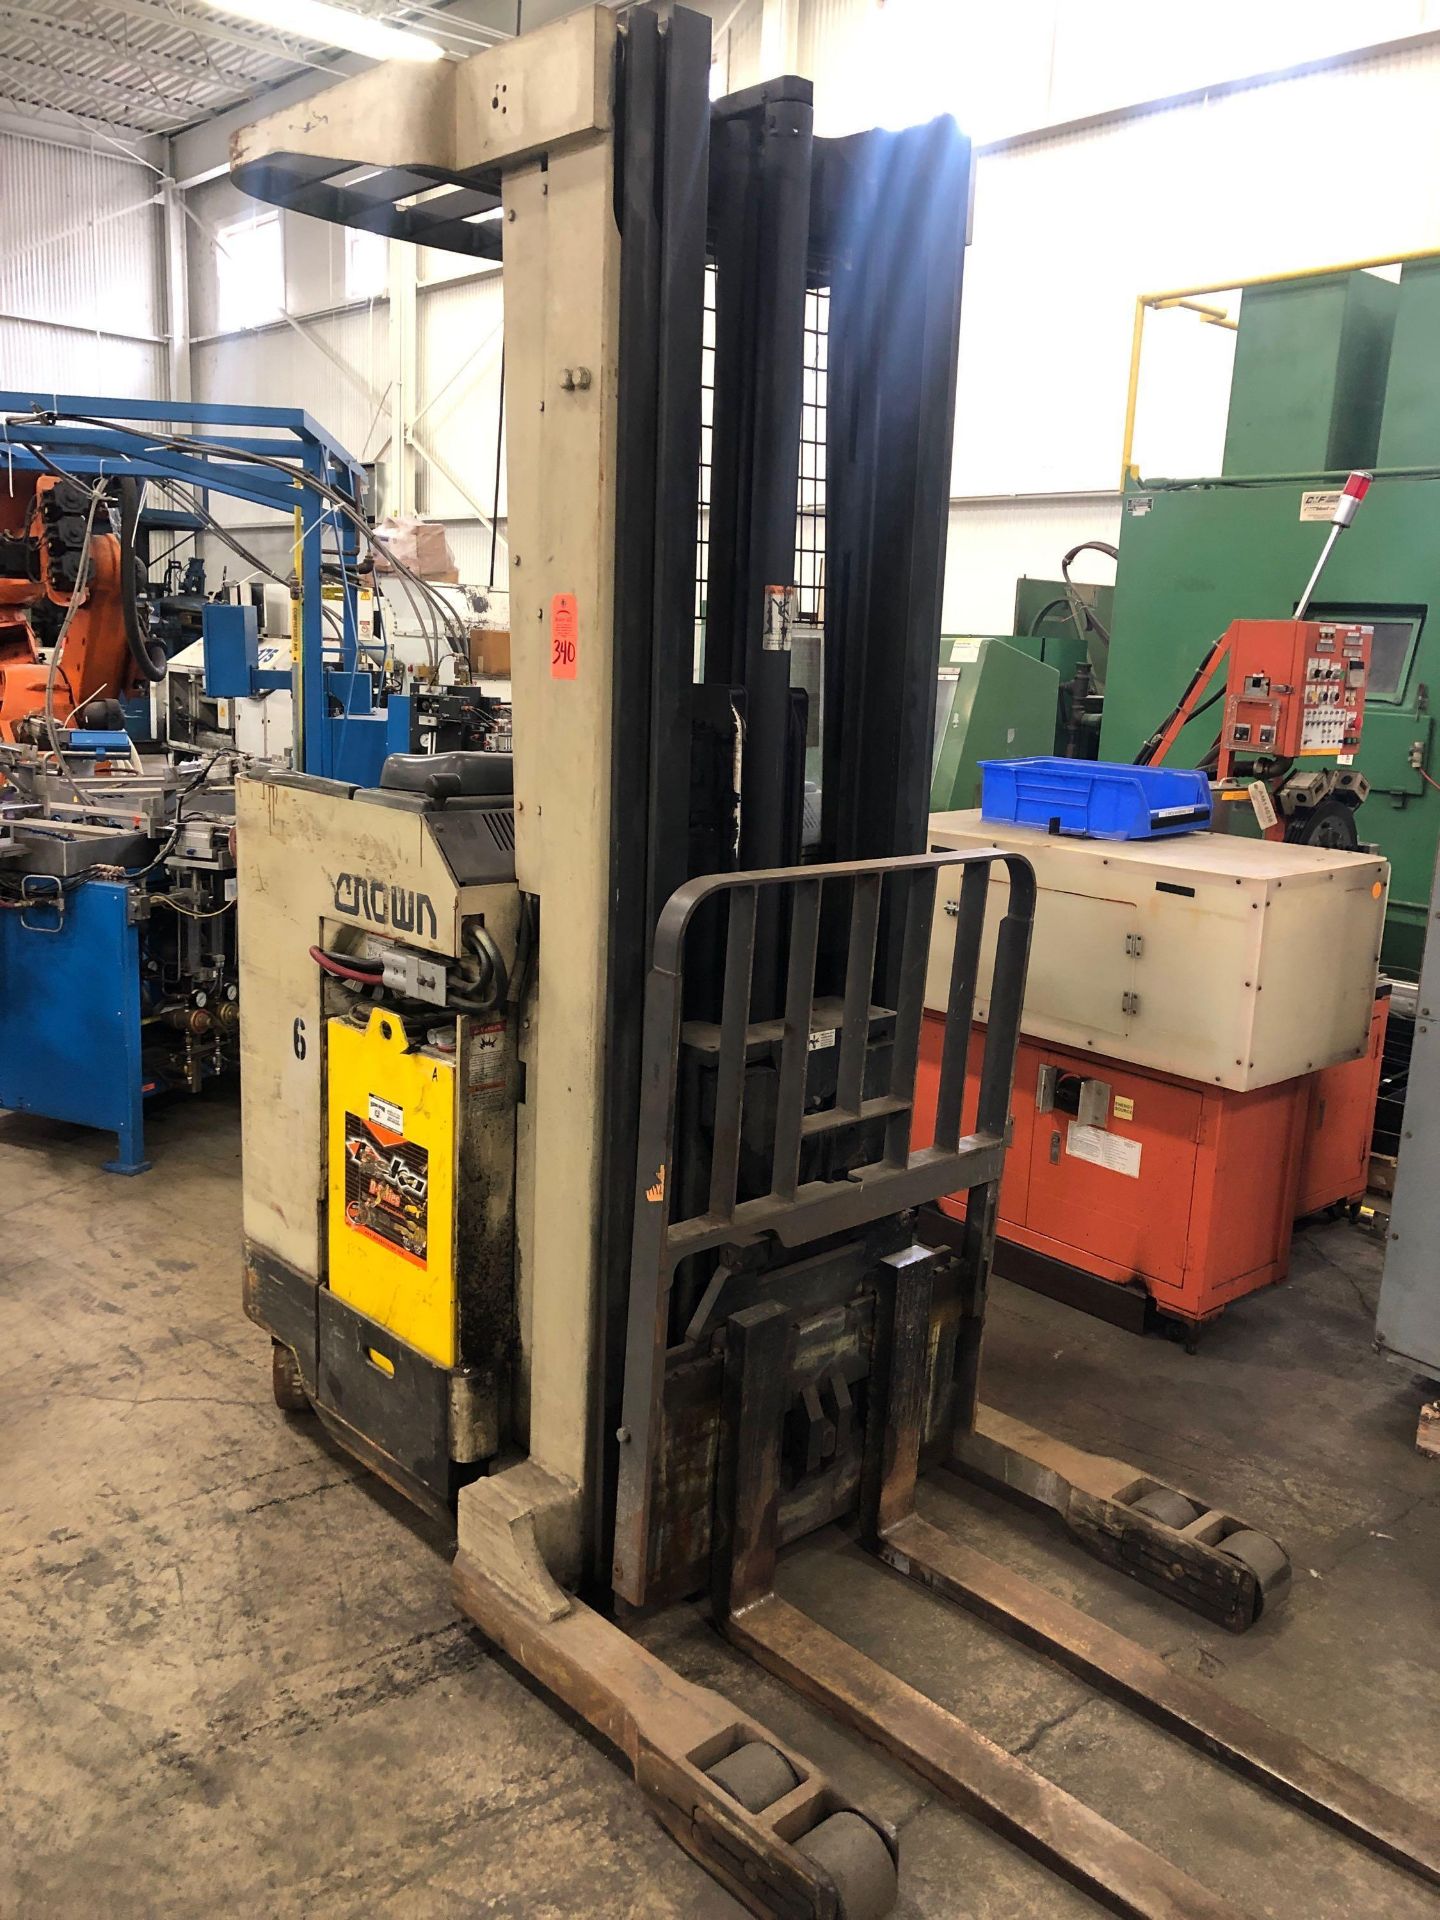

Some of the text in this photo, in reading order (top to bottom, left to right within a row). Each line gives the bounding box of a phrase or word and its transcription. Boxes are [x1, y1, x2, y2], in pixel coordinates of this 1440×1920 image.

[552, 640, 576, 664] 340
[335, 872, 437, 940] CROWN
[294, 1017, 306, 1060] 6
[432, 1066, 438, 1082] A
